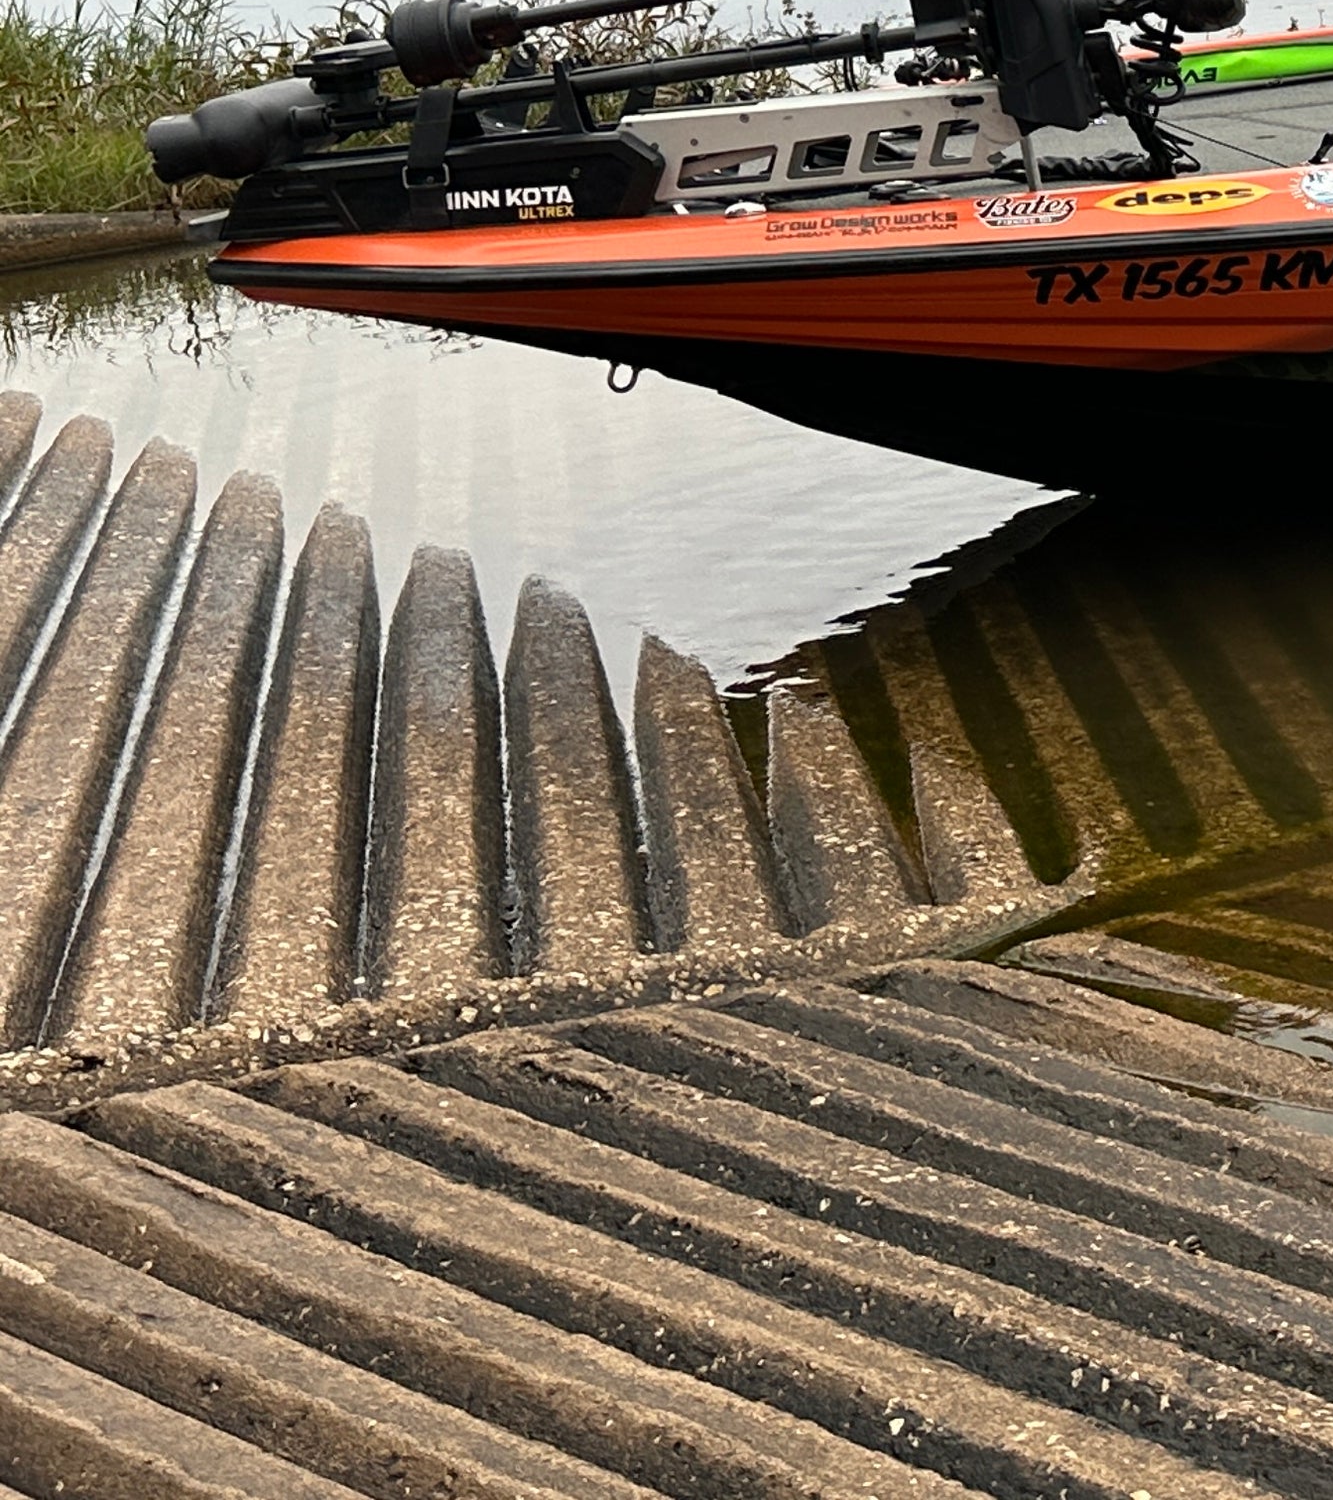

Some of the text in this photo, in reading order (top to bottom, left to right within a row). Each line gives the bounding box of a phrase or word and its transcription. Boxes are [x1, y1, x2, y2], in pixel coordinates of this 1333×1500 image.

[505, 185, 574, 207] KOTA
[1114, 188, 1255, 208] deps
[518, 204, 575, 220] ULTREX
[976, 195, 1075, 219] Bates
[766, 219, 818, 233] Grow
[820, 213, 890, 230] Design
[1026, 265, 1110, 306] TX
[1121, 255, 1250, 301] 1565
